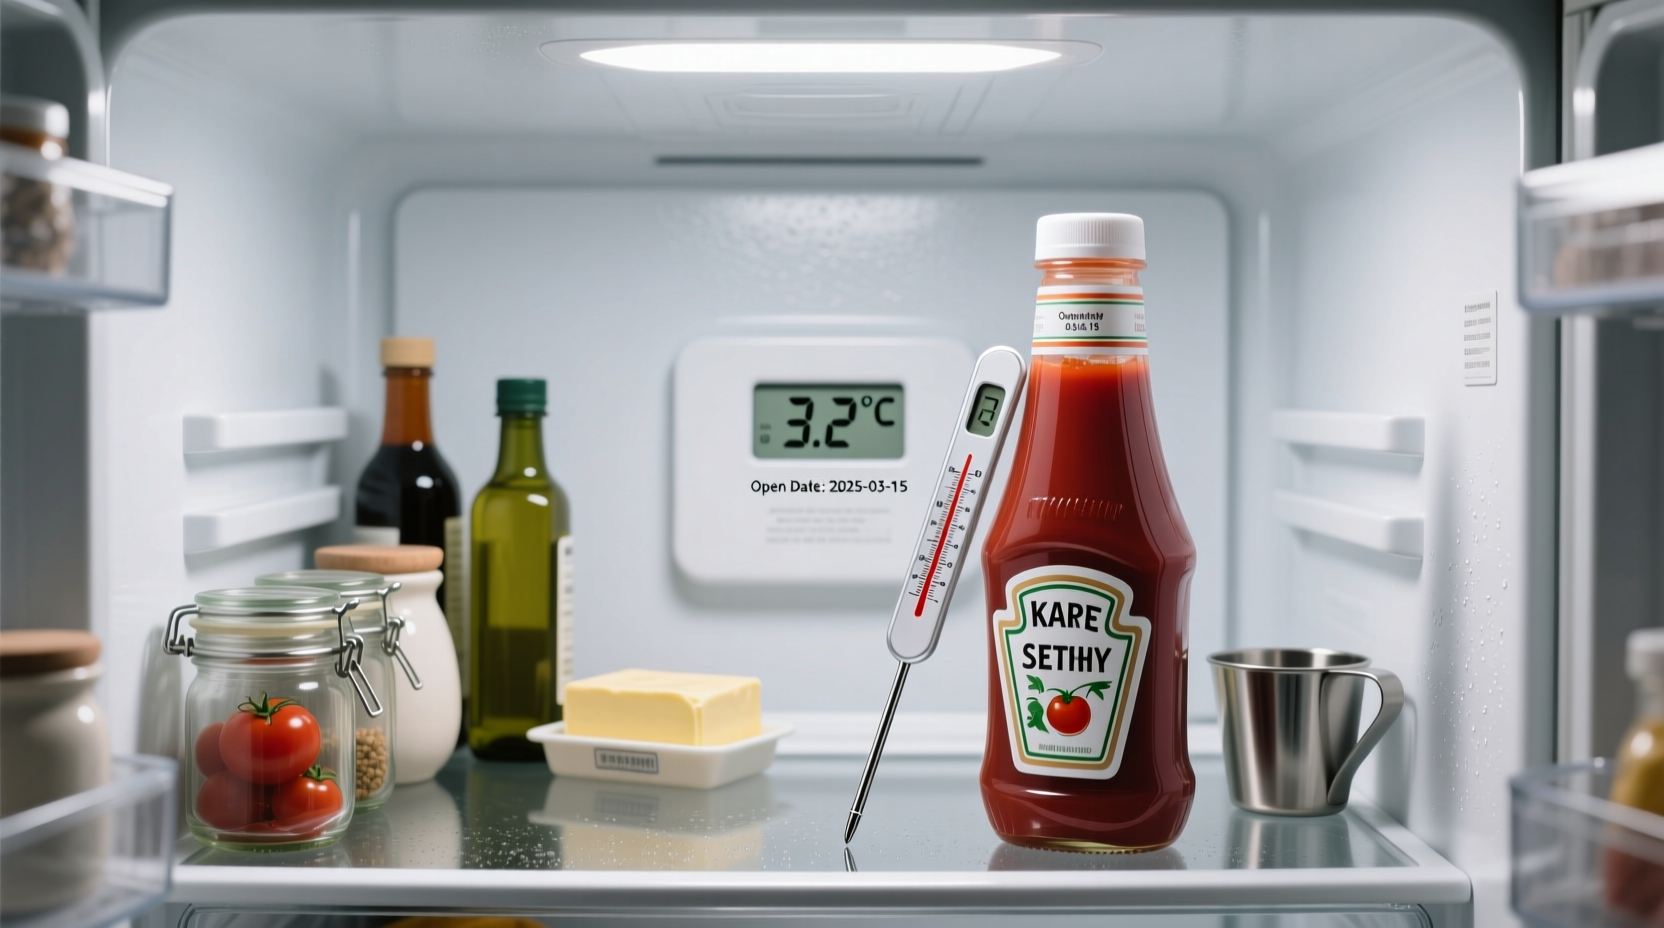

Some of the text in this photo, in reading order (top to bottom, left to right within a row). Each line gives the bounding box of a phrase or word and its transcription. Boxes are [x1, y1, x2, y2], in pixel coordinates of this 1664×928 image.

[751, 479, 908, 496] Open Date: 2025-03-15
[1031, 600, 1102, 632] KARE
